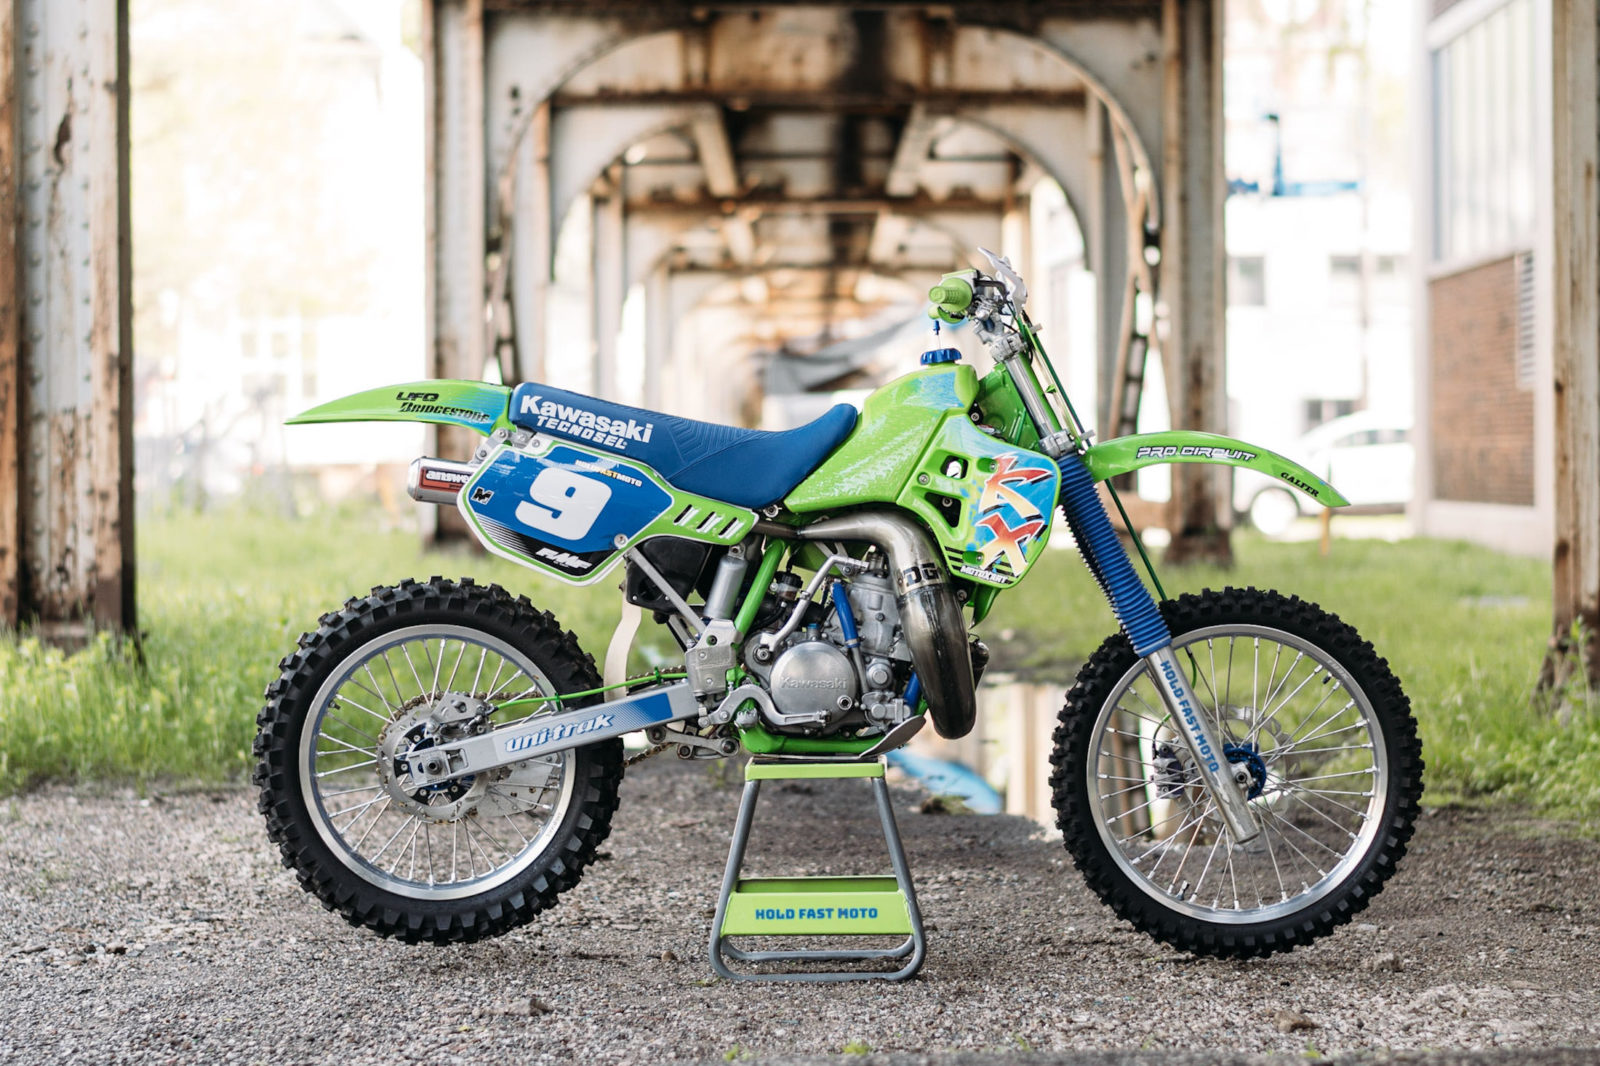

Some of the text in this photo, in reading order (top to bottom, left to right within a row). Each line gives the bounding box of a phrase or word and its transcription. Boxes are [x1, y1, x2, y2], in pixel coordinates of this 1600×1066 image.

[400, 401, 491, 421] BRIDGESTONE
[520, 394, 654, 443] Kawasaki
[536, 415, 628, 450] TECNOSEL
[1136, 446, 1257, 462] PRO CIRCUIT
[425, 470, 471, 484] answe
[1280, 471, 1320, 498] GALFER
[515, 467, 612, 541] 9
[903, 562, 940, 585] DG
[781, 676, 848, 689] Kawasaki
[1160, 660, 1219, 773] HOLD FAST MOTO
[505, 713, 616, 752] uni-trak
[755, 907, 878, 920] HOLD FAST MOTO
